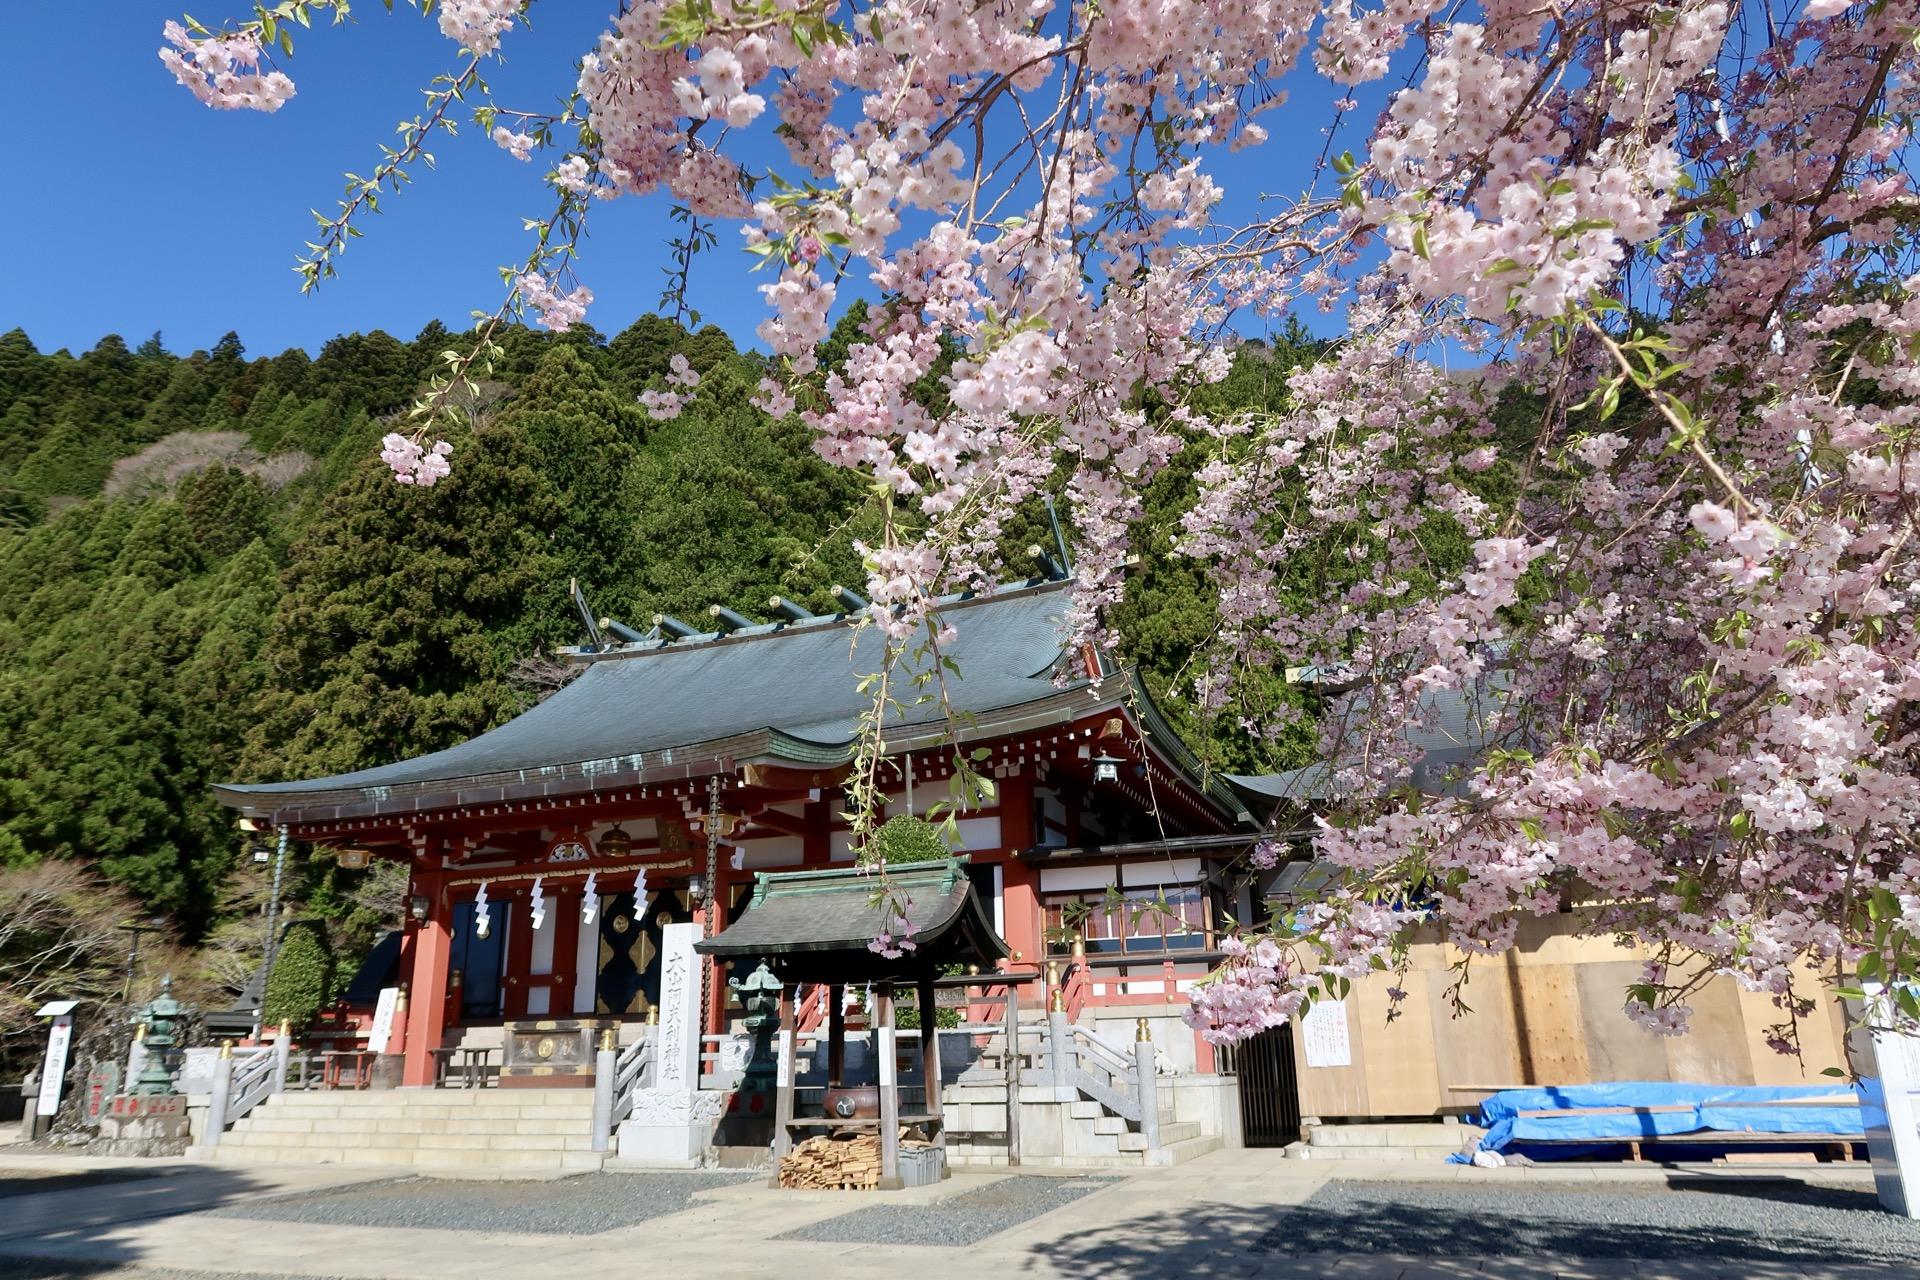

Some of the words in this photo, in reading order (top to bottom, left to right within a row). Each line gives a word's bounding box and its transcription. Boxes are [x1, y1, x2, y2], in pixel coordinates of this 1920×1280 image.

[663, 952, 686, 1080] 大山阿夫利神社
